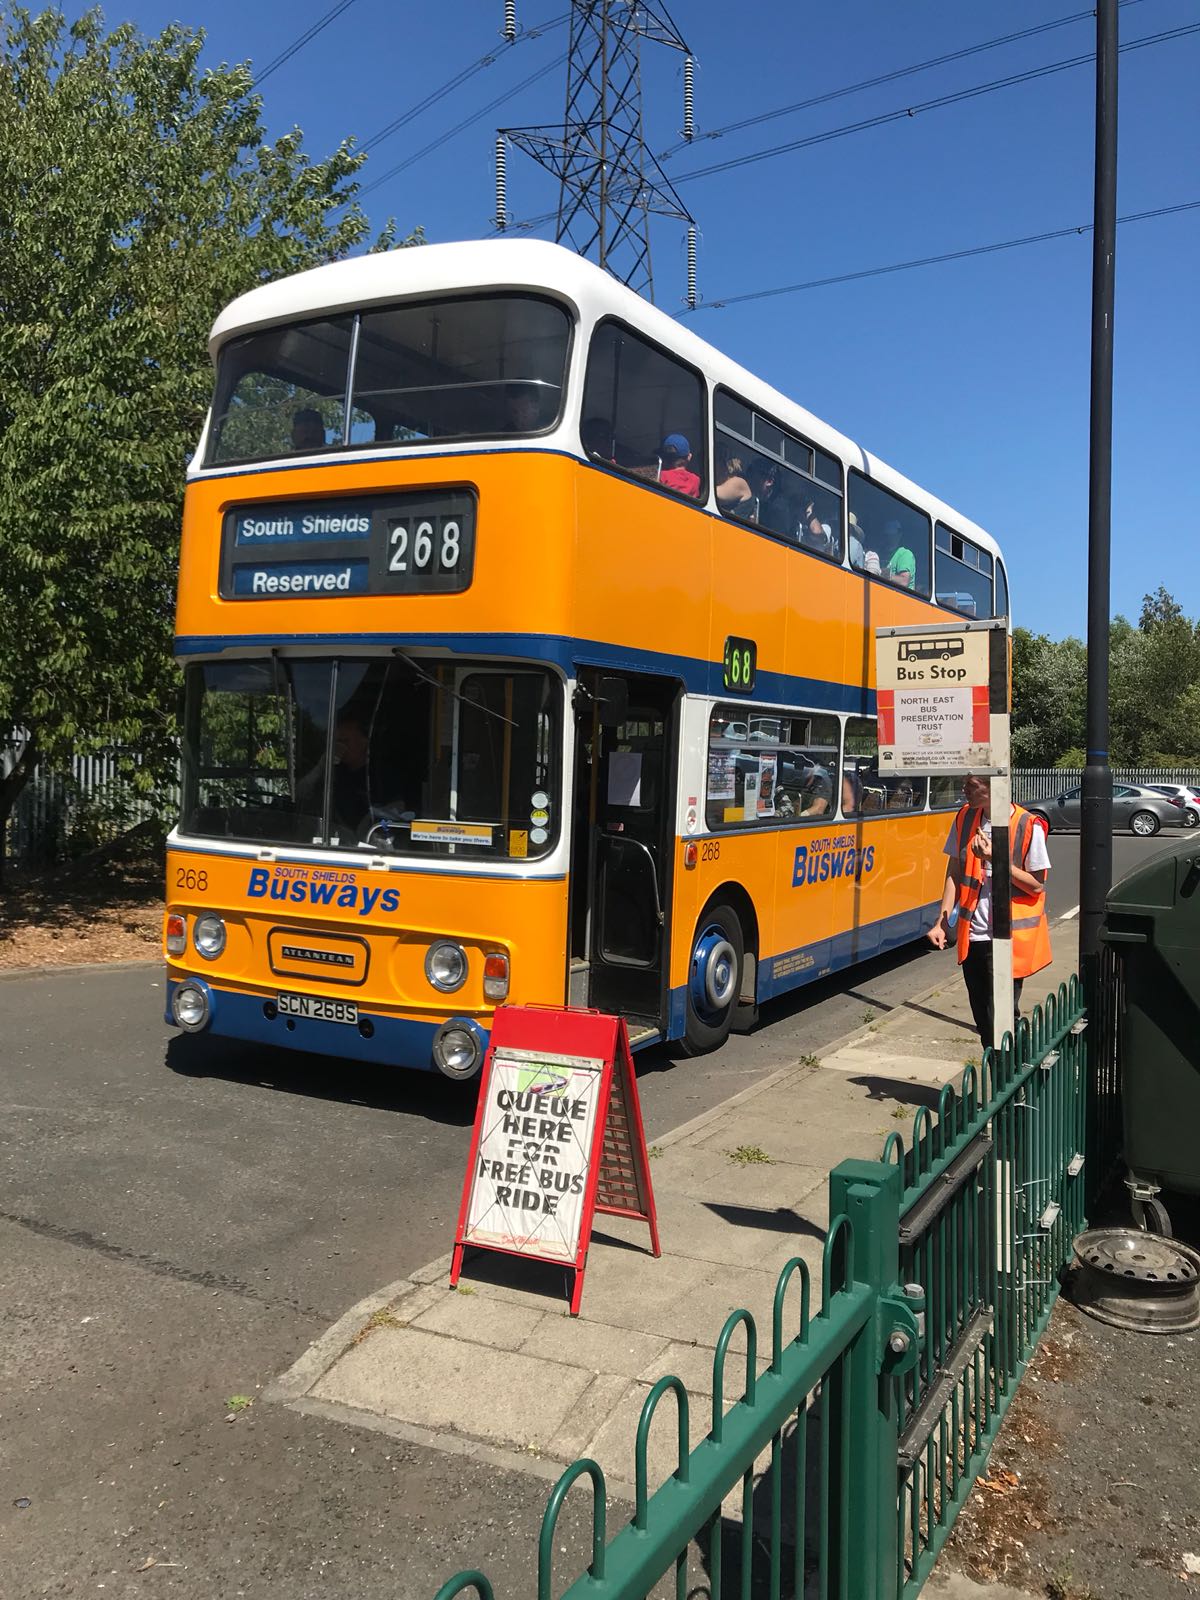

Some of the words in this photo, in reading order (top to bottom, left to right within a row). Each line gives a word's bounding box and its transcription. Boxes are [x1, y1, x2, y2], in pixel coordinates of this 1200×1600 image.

[243, 517, 293, 537] South
[302, 514, 369, 534] Shields
[389, 521, 460, 571] 268
[253, 568, 351, 593] Reserved
[897, 667, 925, 680] Bus
[930, 665, 967, 681] Stop
[900, 697, 929, 705] NORTH
[933, 696, 955, 704] EAST
[901, 714, 964, 722] PRESERVATION
[437, 826, 465, 835] Busways
[702, 842, 720, 861] 268
[810, 838, 831, 853] SOUTH
[832, 835, 855, 849] SHIELDS
[275, 867, 309, 879] SOUTH
[311, 870, 356, 884] SHIELDS
[792, 846, 875, 888] Busways
[176, 868, 208, 891] 268
[247, 868, 401, 916] Busways
[283, 948, 353, 964] ATLANTEAN
[280, 994, 310, 1015] SCN
[313, 1000, 356, 1022] 268S
[496, 1089, 587, 1120] QUEUE
[502, 1117, 573, 1143] HERE
[506, 1139, 560, 1166] FOR
[478, 1160, 531, 1185] FREE
[538, 1172, 585, 1195] BUS
[495, 1186, 559, 1216] RIDE
